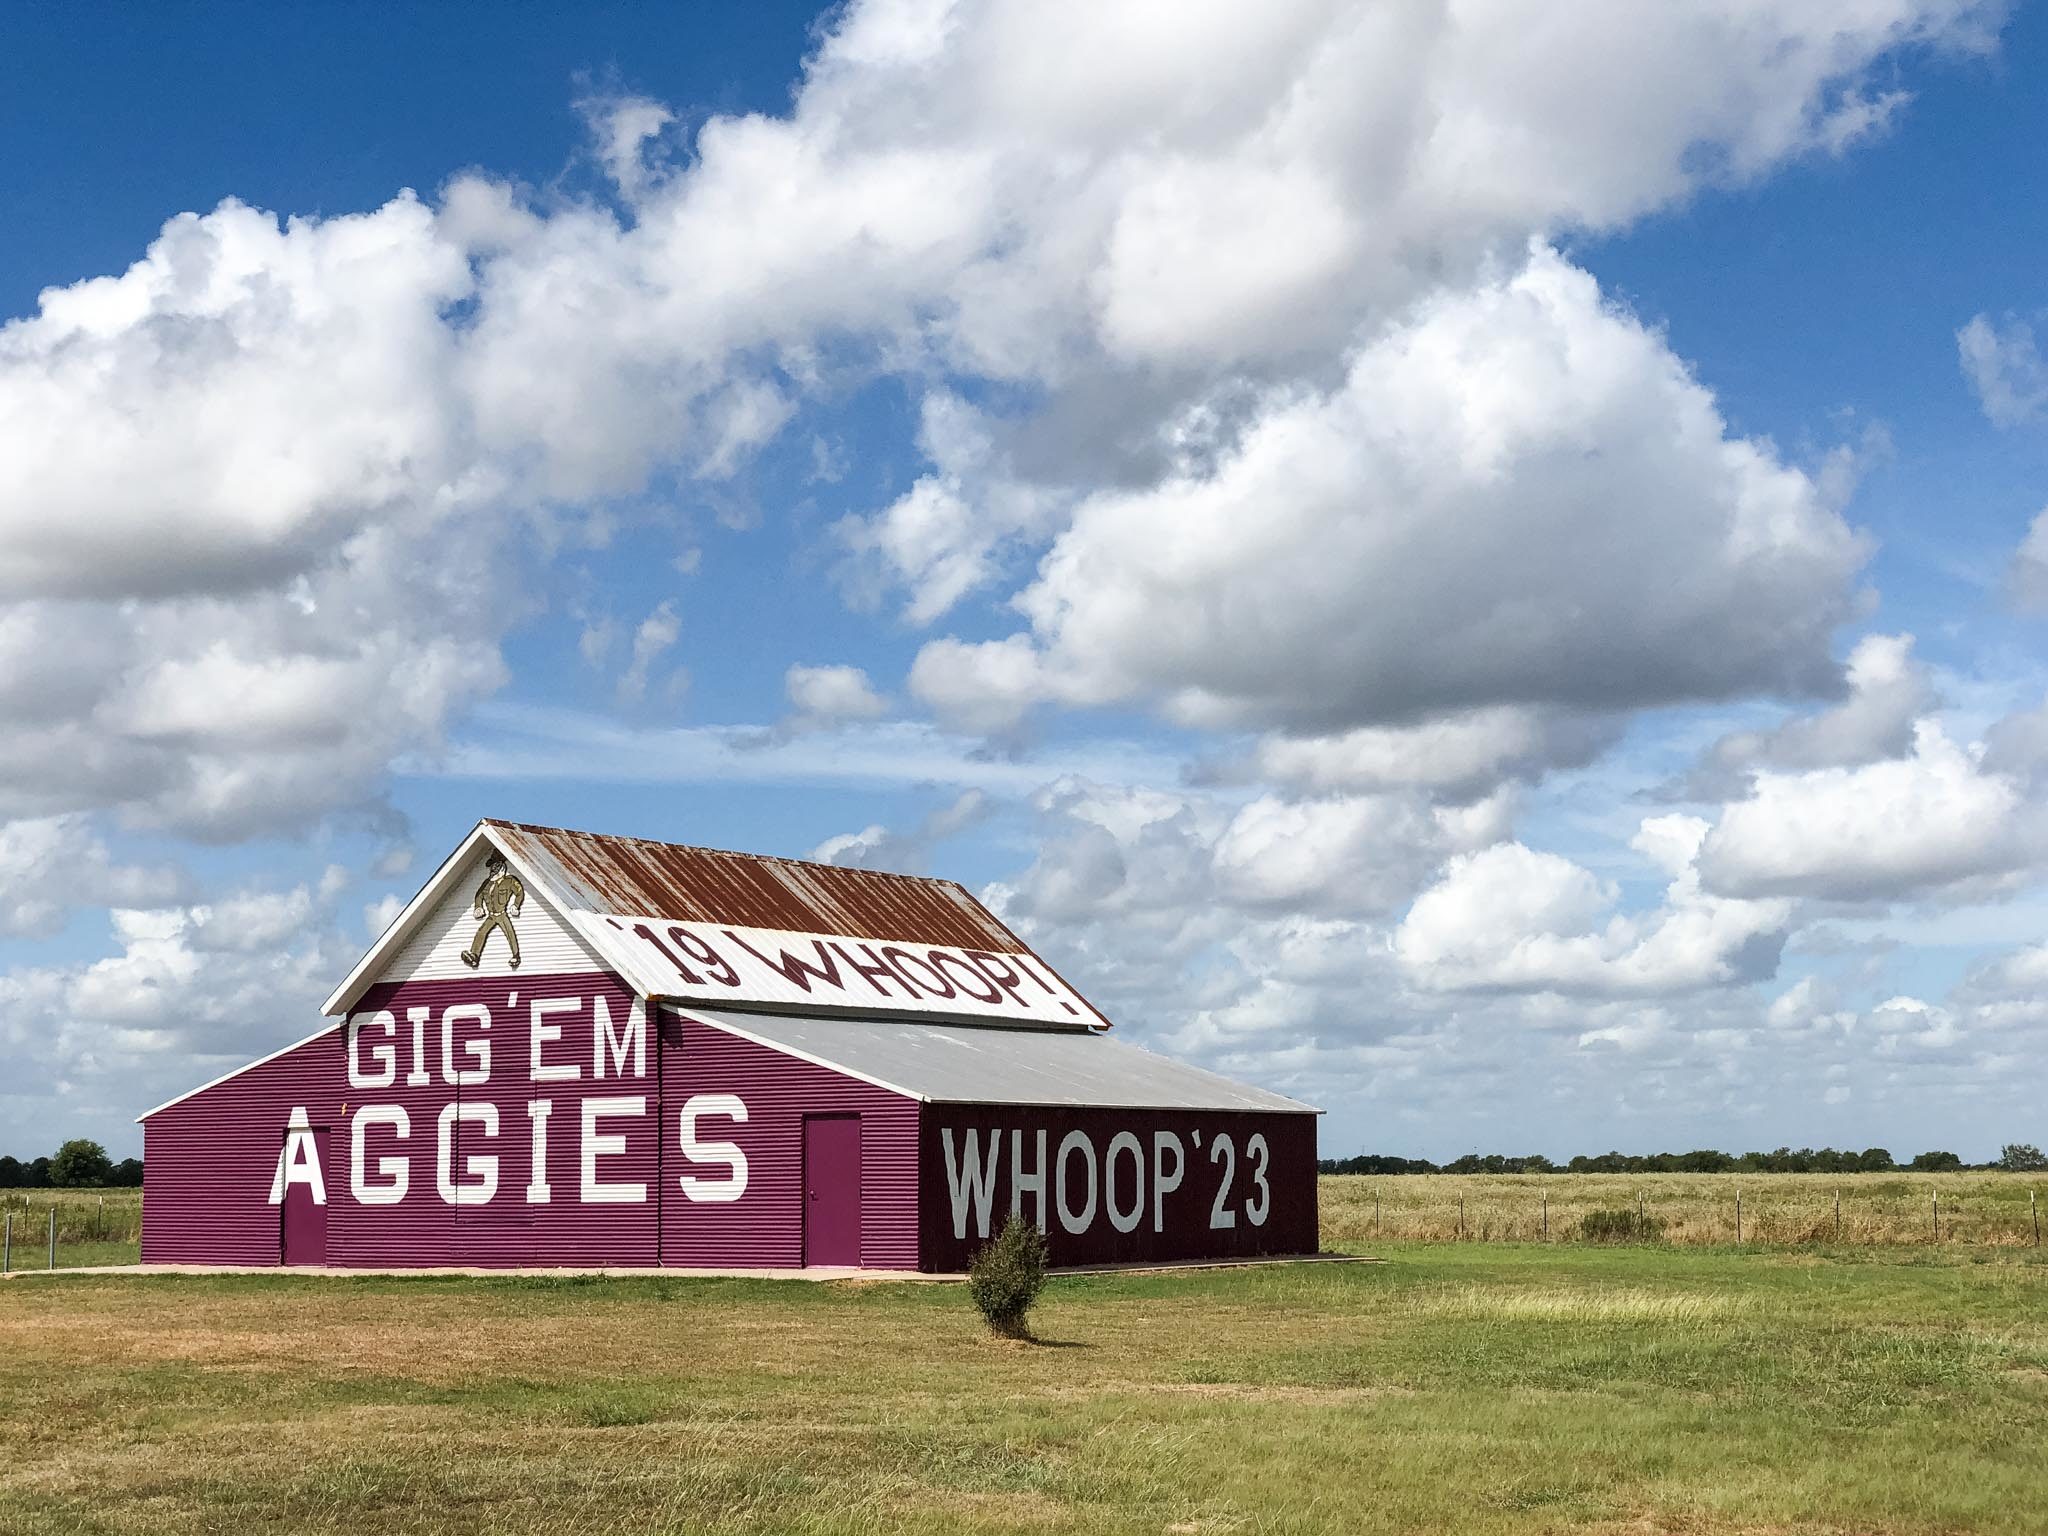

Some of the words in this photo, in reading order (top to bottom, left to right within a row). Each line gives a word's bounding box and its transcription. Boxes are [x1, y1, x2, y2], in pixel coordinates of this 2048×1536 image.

[607, 918, 741, 987] '19
[722, 931, 1079, 1015] WHOOP!
[268, 1094, 748, 1205] AGGIES
